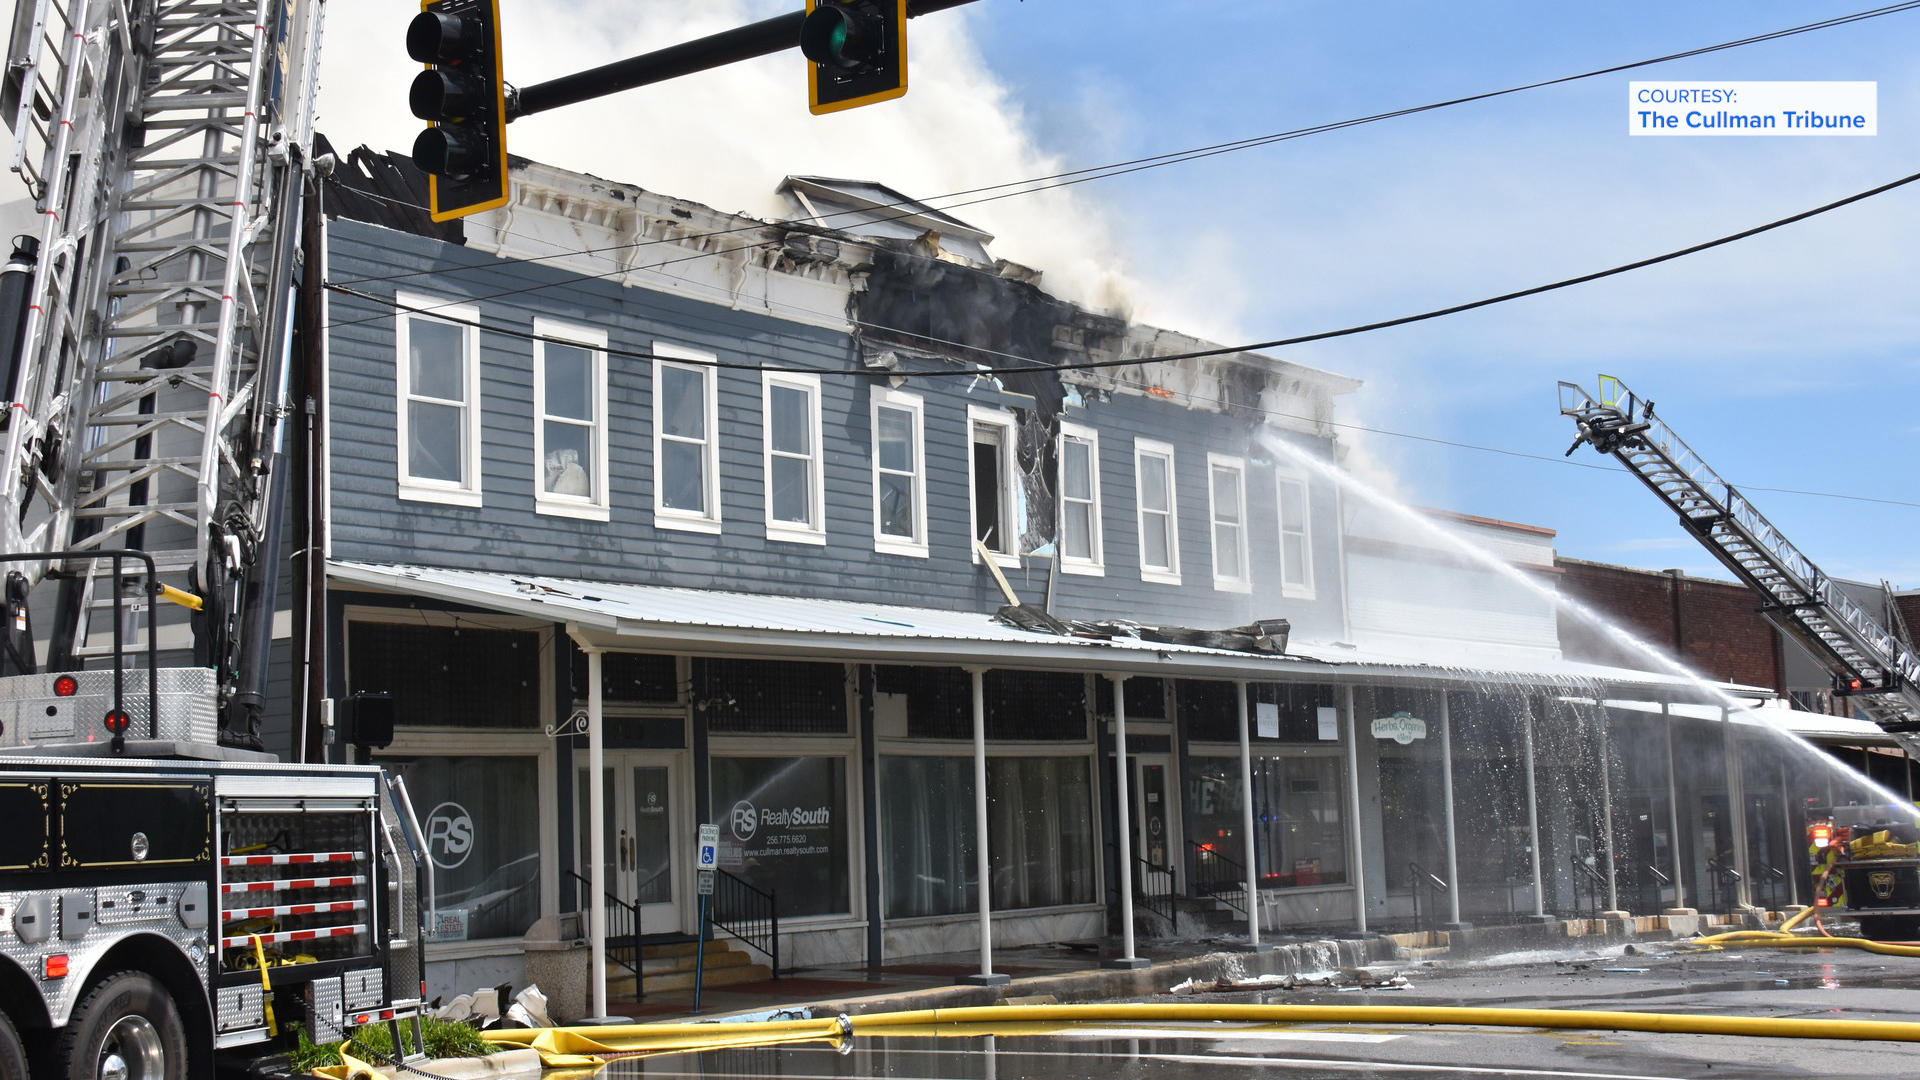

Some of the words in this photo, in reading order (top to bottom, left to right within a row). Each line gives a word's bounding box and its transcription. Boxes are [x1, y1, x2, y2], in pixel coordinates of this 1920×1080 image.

[733, 808, 756, 832] RS
[761, 807, 829, 829] RealtySouth
[428, 815, 472, 854] RS
[766, 835, 806, 845] 256.775.6620
[744, 846, 829, 857] www.cullman.realtysouth.com
[444, 916, 462, 924] REAL
[440, 923, 465, 933] ESTATE
